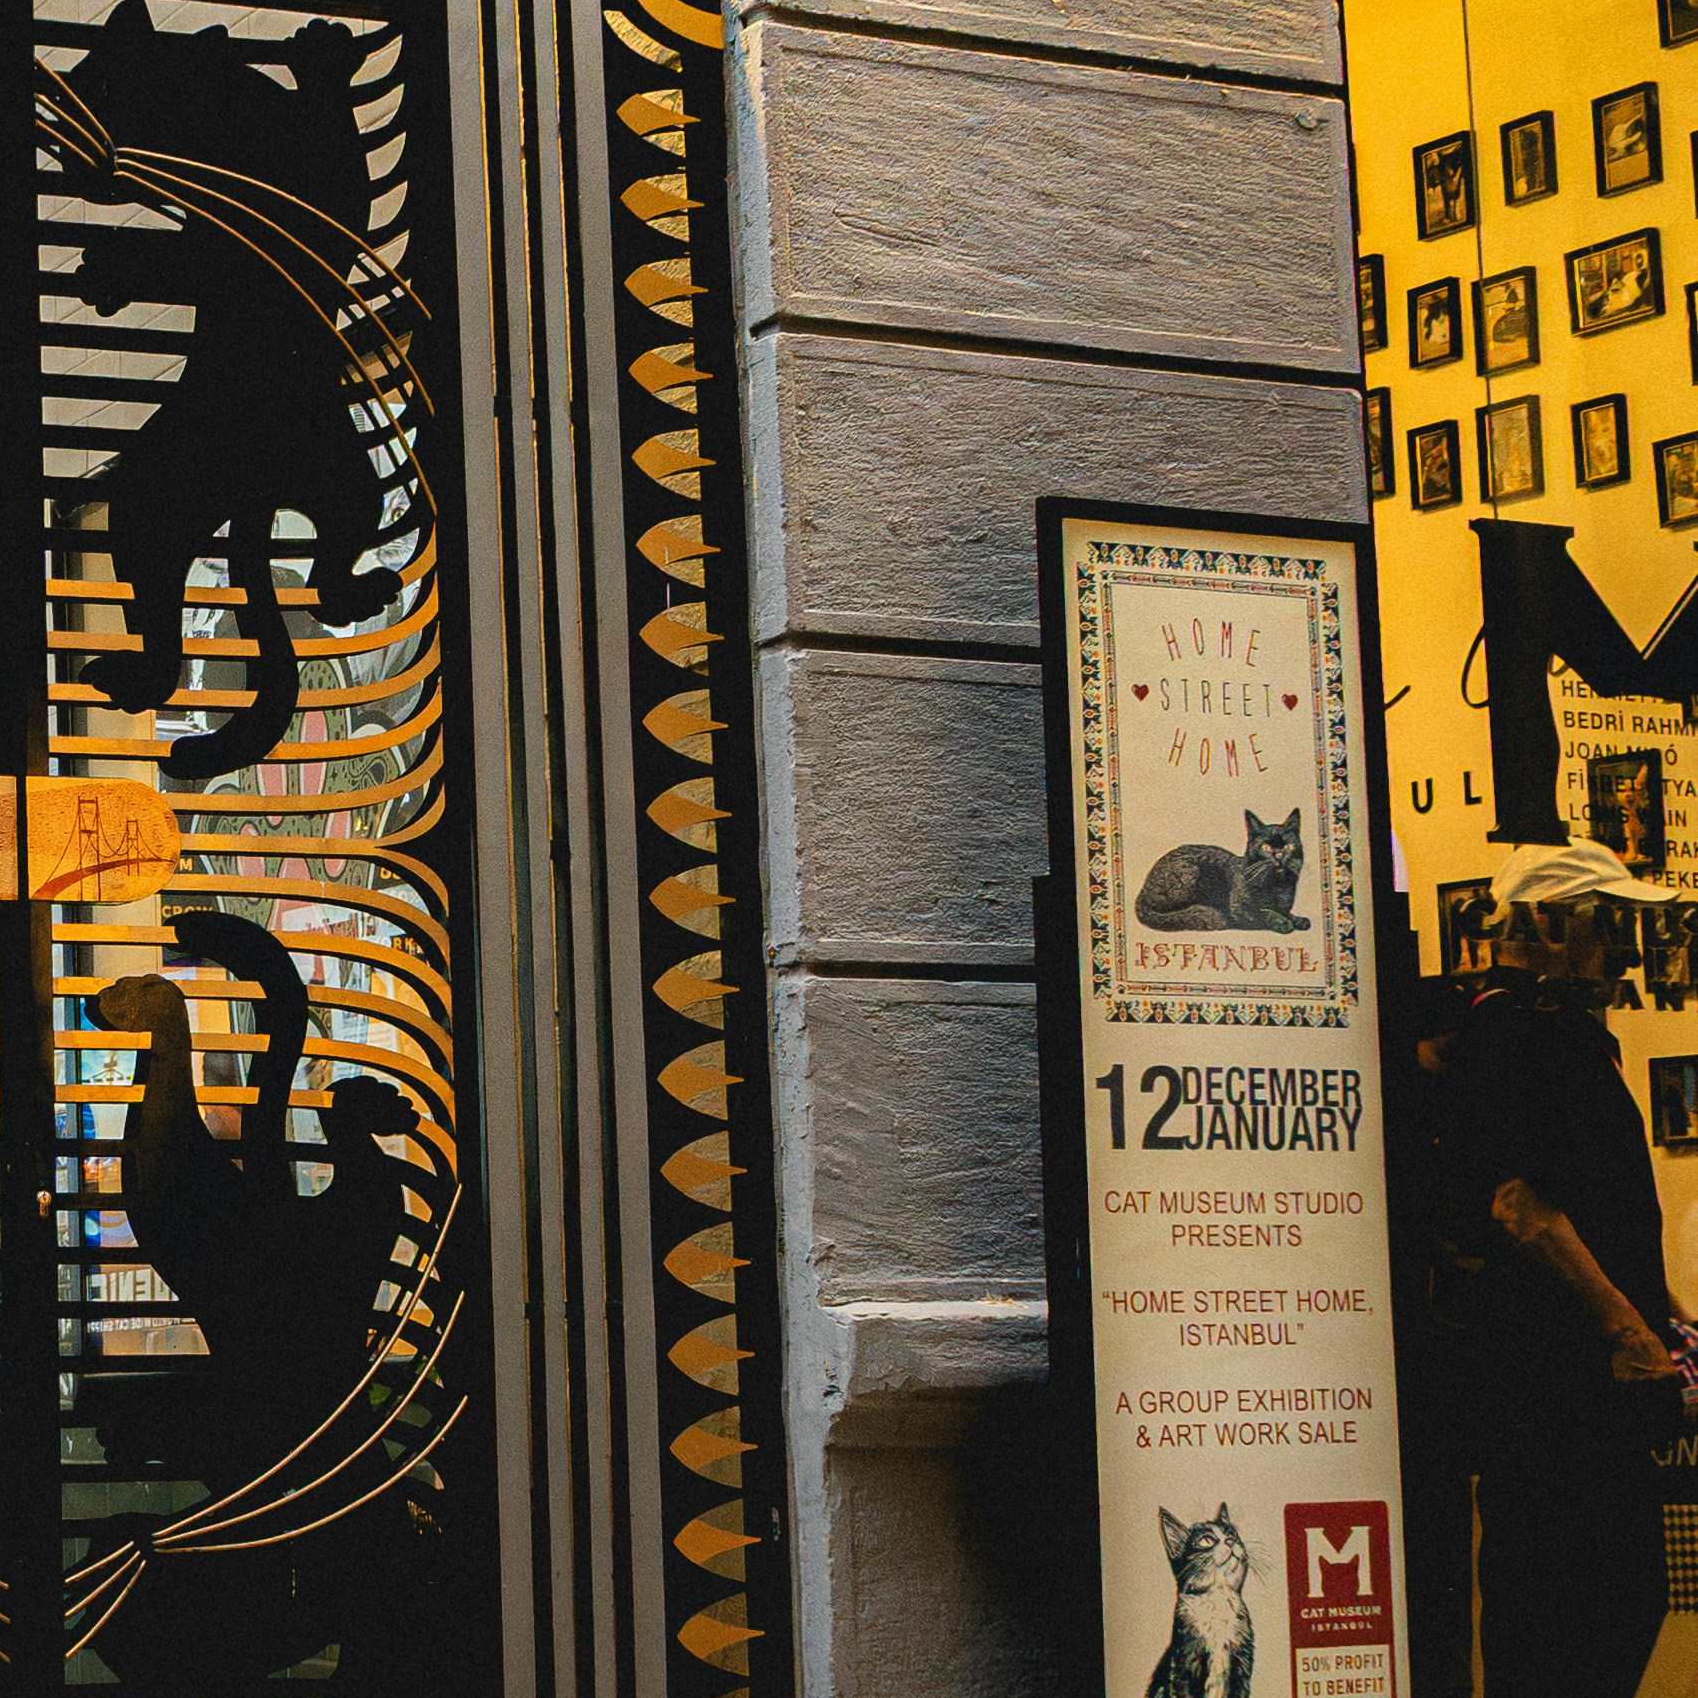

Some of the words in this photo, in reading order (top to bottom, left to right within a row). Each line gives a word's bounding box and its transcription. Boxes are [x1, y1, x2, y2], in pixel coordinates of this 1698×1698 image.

[1161, 618, 1261, 667] HOME
[1160, 678, 1271, 718] STREET
[1168, 728, 1269, 777] HOME
[1135, 941, 1318, 973] ISTANBUL
[1095, 1063, 1186, 1151] 12
[1182, 1066, 1361, 1107] DECEMBER
[1186, 1105, 1362, 1151] JANUARY
[1104, 1191, 1151, 1214] CAT
[1160, 1191, 1266, 1214] MUSEUM
[1275, 1191, 1363, 1214] STUDIO
[1171, 1224, 1302, 1247] PRESENTS
[1194, 1290, 1287, 1313] STREET
[1296, 1289, 1374, 1315] HOME,
[1115, 1392, 1132, 1415] A
[1140, 1390, 1228, 1414] GROUP
[1238, 1388, 1372, 1412] EXHIBITION
[1136, 1426, 1151, 1448] &
[1158, 1424, 1207, 1447] ART
[1215, 1422, 1290, 1445] WORK
[1298, 1421, 1357, 1443] SALE
[1305, 1526, 1372, 1598] M
[1301, 1606, 1326, 1619] CAT
[1328, 1605, 1382, 1618] MUSEUM
[1302, 1656, 1330, 1673] 50%
[1335, 1653, 1384, 1672] PROFIT
[1303, 1679, 1321, 1696] TO
[1326, 1676, 1384, 1695] BENEFIT
